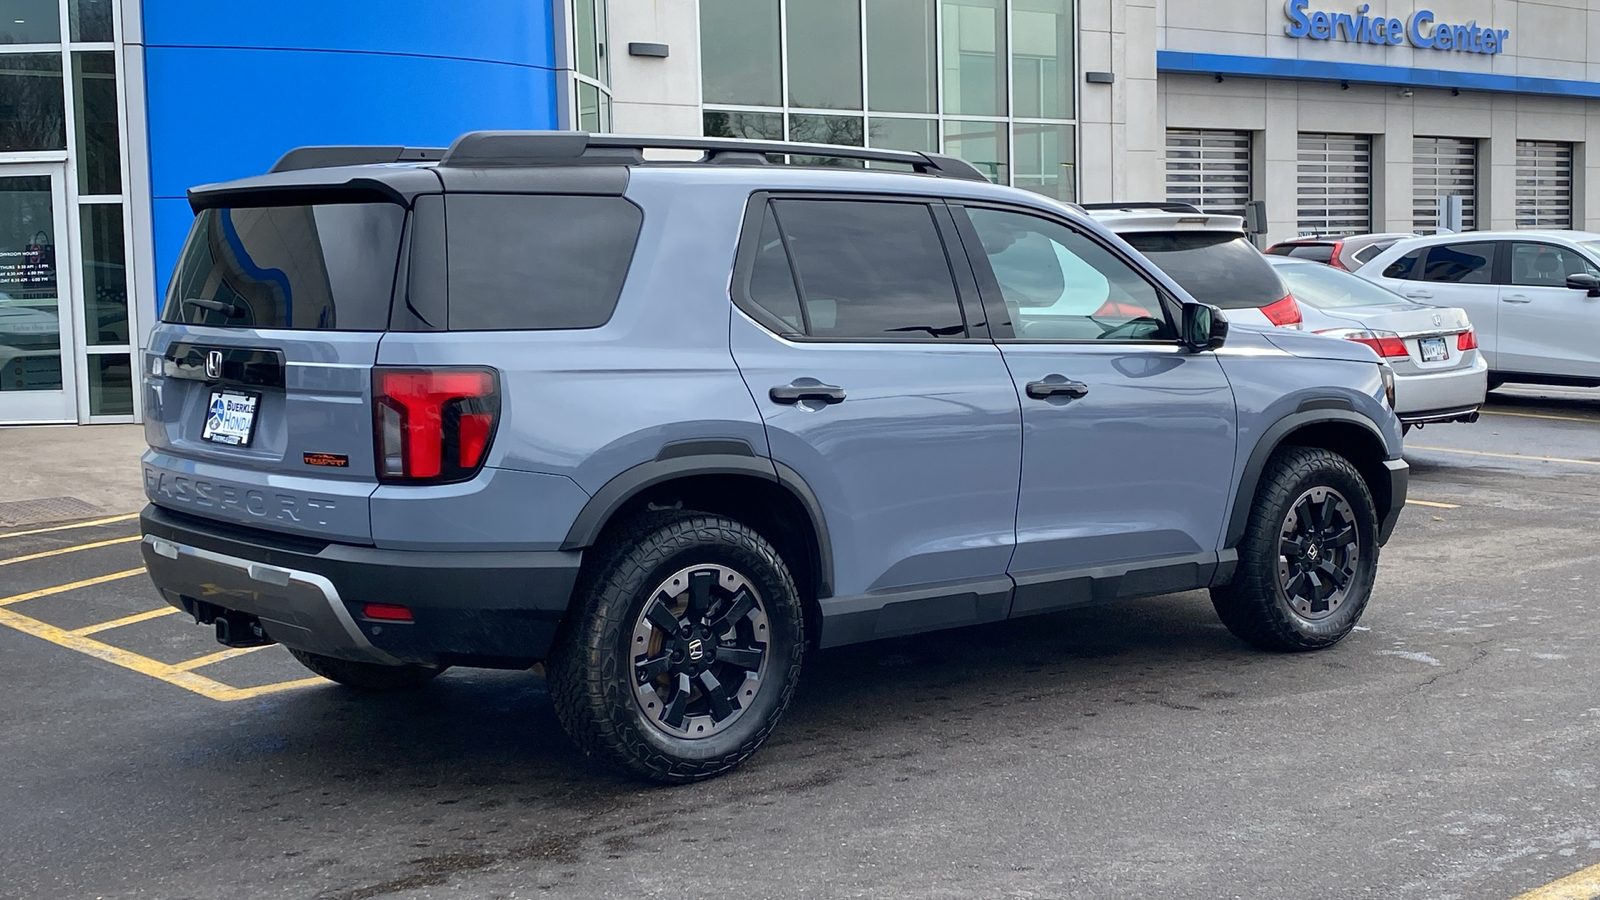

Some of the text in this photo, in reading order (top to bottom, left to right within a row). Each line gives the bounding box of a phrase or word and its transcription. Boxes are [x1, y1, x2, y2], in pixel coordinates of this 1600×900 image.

[1285, 0, 1509, 54] Service Center
[223, 411, 251, 431] HONDA
[226, 400, 255, 413] BUERKLE
[144, 467, 336, 525] PASSPORT
